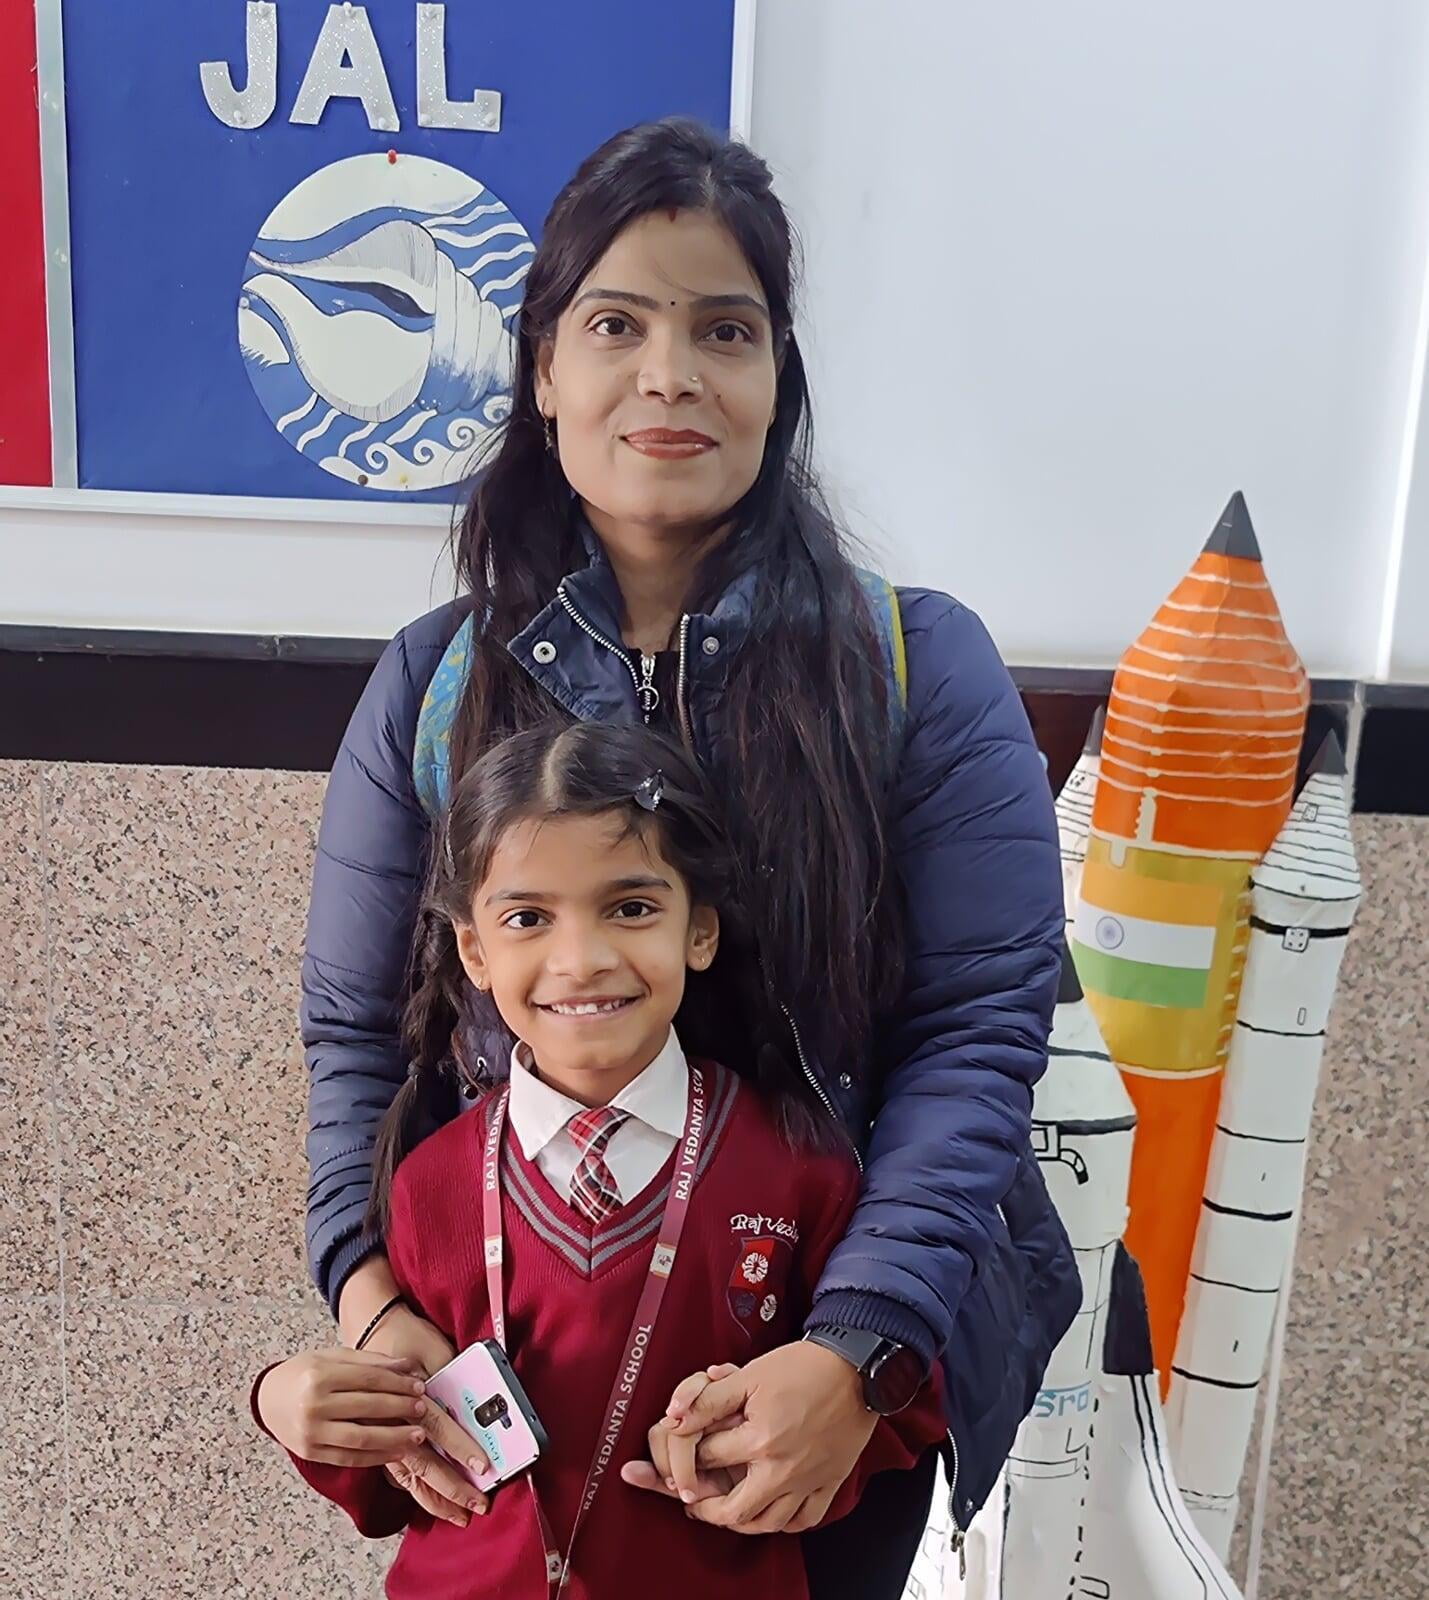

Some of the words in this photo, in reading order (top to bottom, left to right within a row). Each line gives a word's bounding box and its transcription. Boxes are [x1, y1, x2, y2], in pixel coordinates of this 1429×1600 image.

[199, 1, 502, 132] JAL
[682, 1098, 704, 1166] VEDANTA
[486, 1161, 496, 1191] RAJ
[675, 1171, 692, 1200] RAJ
[583, 1482, 599, 1510] RAJ
[594, 1399, 628, 1476] VEDANTA
[620, 1324, 652, 1394] SCHOOL
